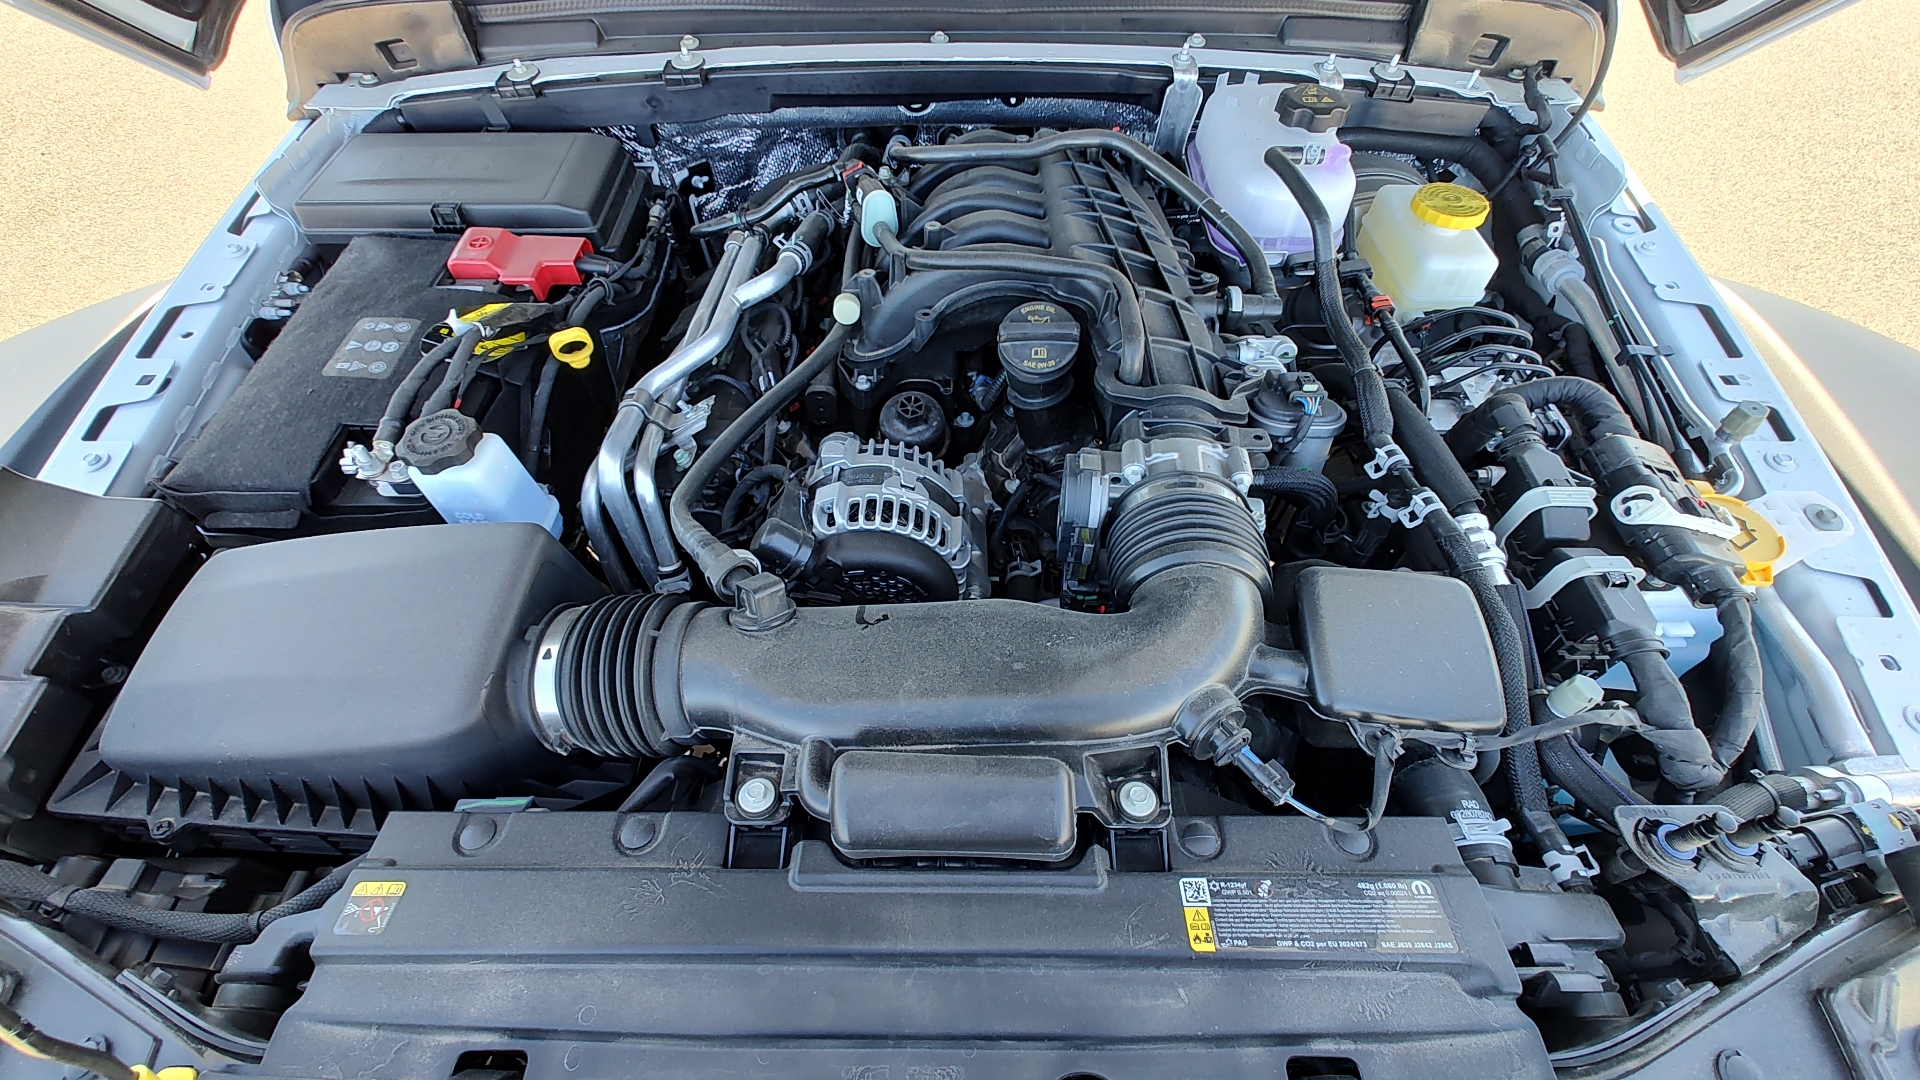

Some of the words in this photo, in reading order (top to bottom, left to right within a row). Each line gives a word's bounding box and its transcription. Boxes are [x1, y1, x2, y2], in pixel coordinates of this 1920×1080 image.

[1021, 304, 1045, 315] ENGINE
[1046, 305, 1056, 314] OIL
[1023, 360, 1036, 368] SAE
[1037, 360, 1056, 369] 0W-20
[1460, 799, 1480, 809] RAD
[1220, 881, 1247, 889] R-1234yf
[1357, 882, 1375, 890] 482g
